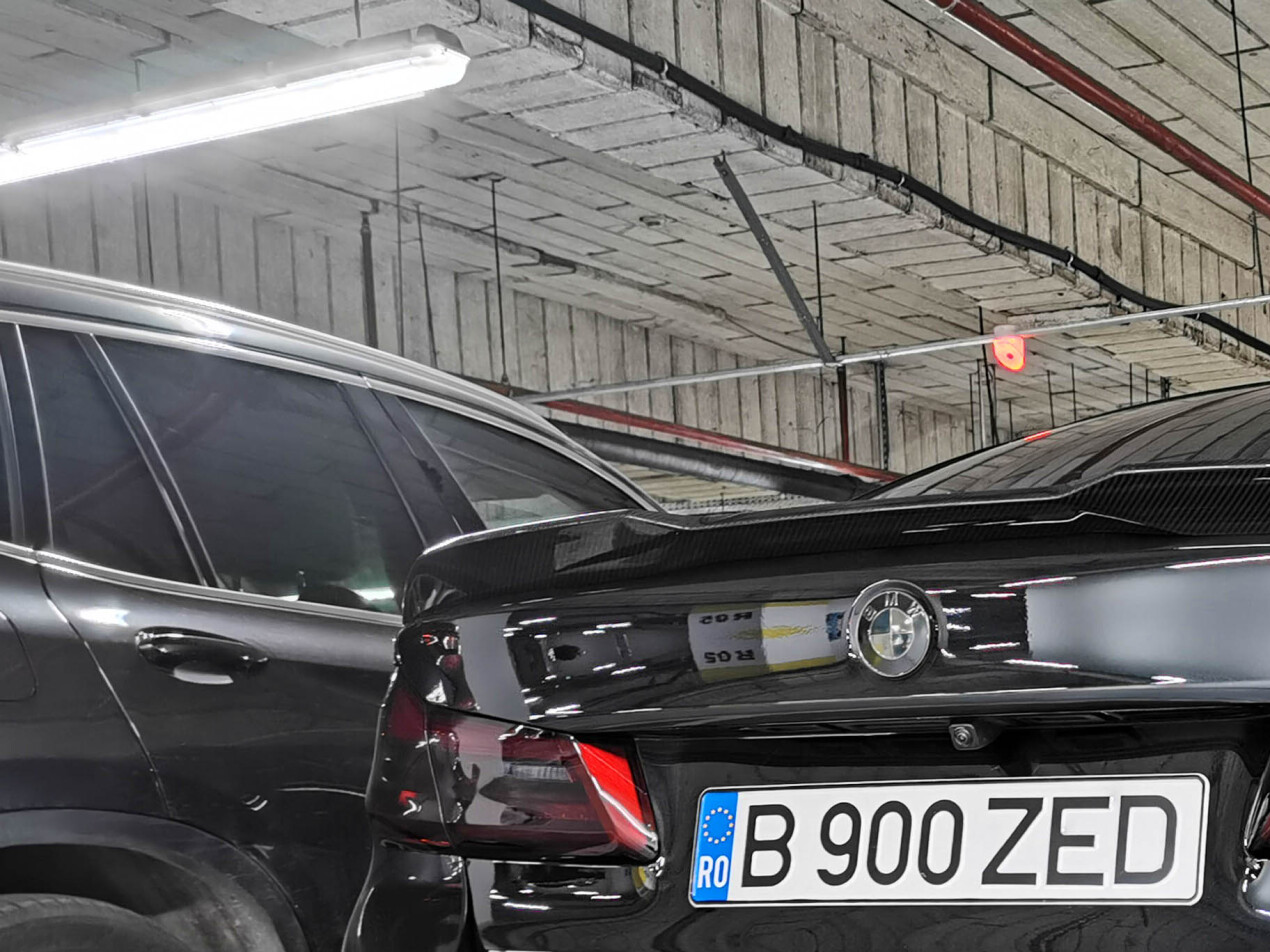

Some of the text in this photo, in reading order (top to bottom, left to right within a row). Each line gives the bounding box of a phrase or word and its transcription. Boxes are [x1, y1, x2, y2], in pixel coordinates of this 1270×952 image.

[697, 854, 730, 889] RO
[740, 795, 1178, 889] B 900 ZED
